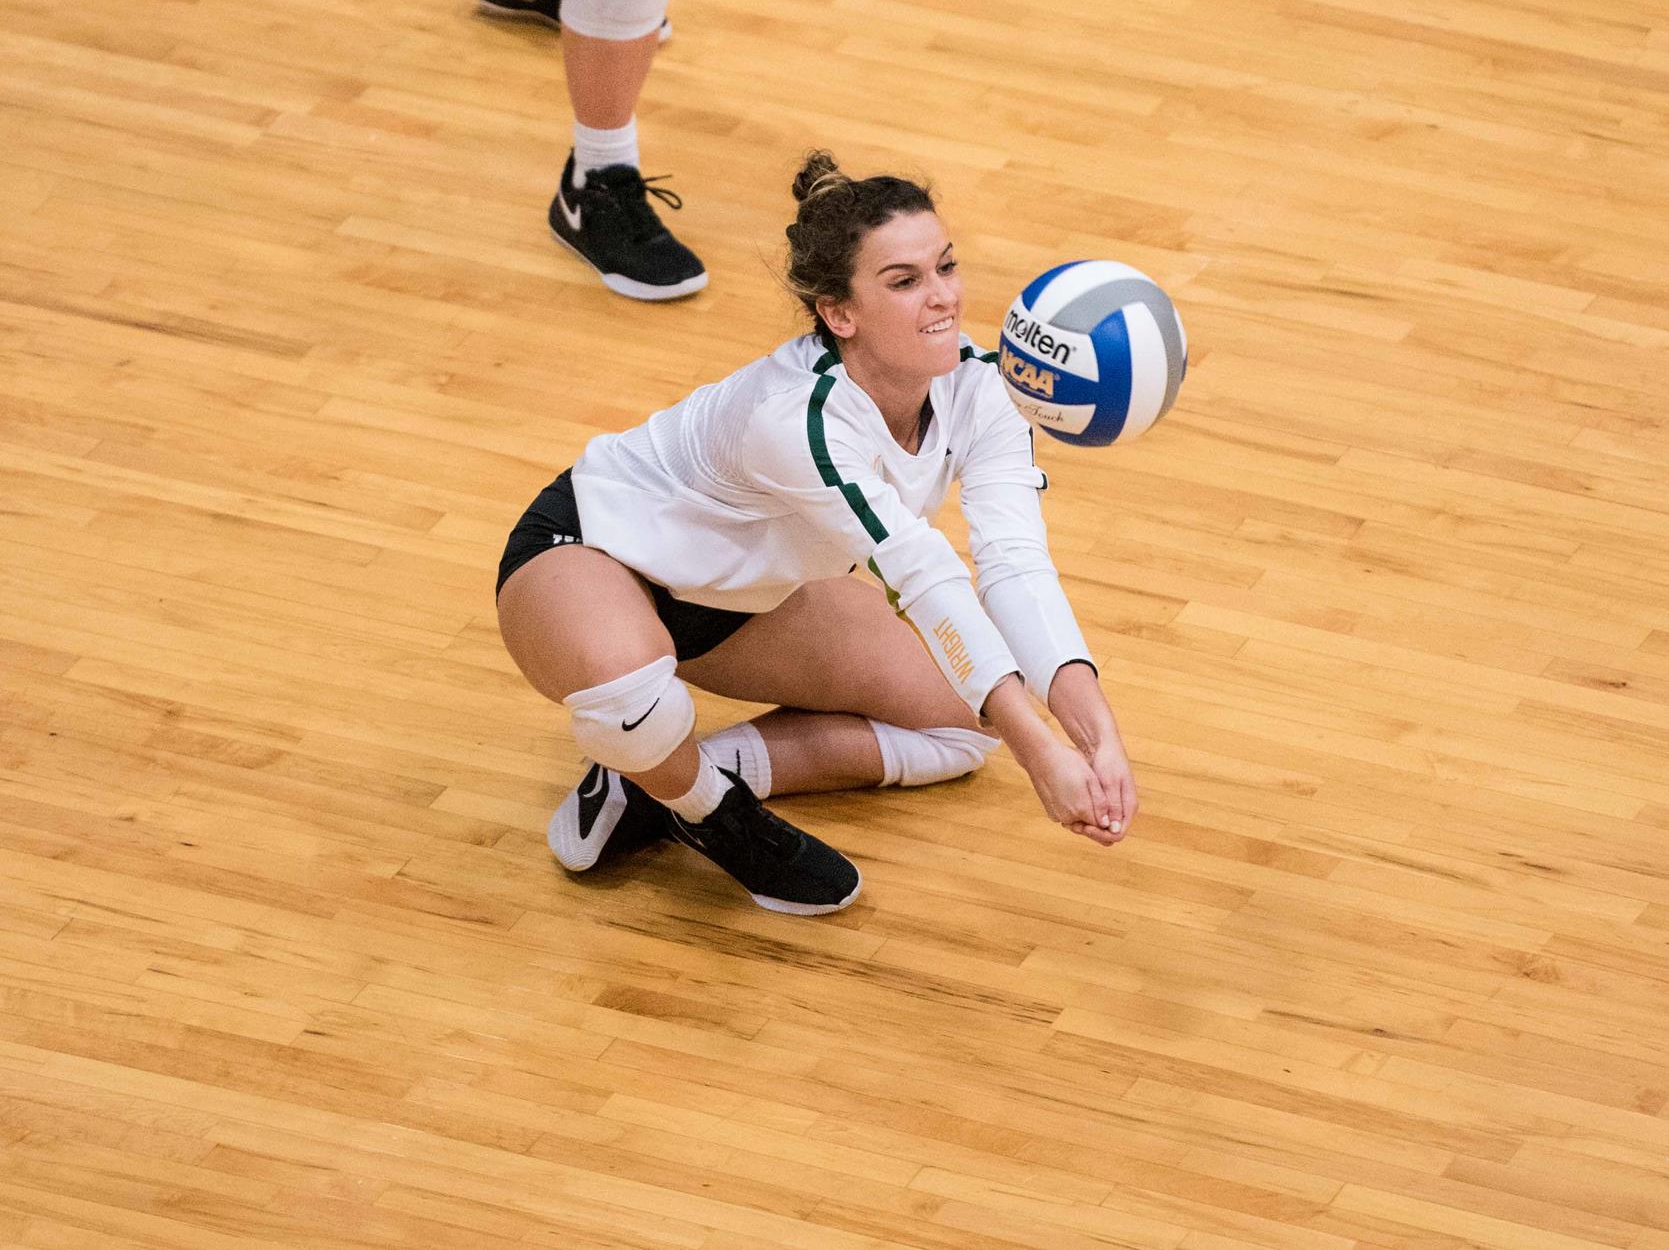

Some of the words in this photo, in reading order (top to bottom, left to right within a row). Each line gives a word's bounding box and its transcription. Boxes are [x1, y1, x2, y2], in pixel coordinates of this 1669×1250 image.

[1006, 310, 1070, 365] molten
[1001, 344, 1054, 398] NCAA
[933, 616, 977, 685] WRIGHT
